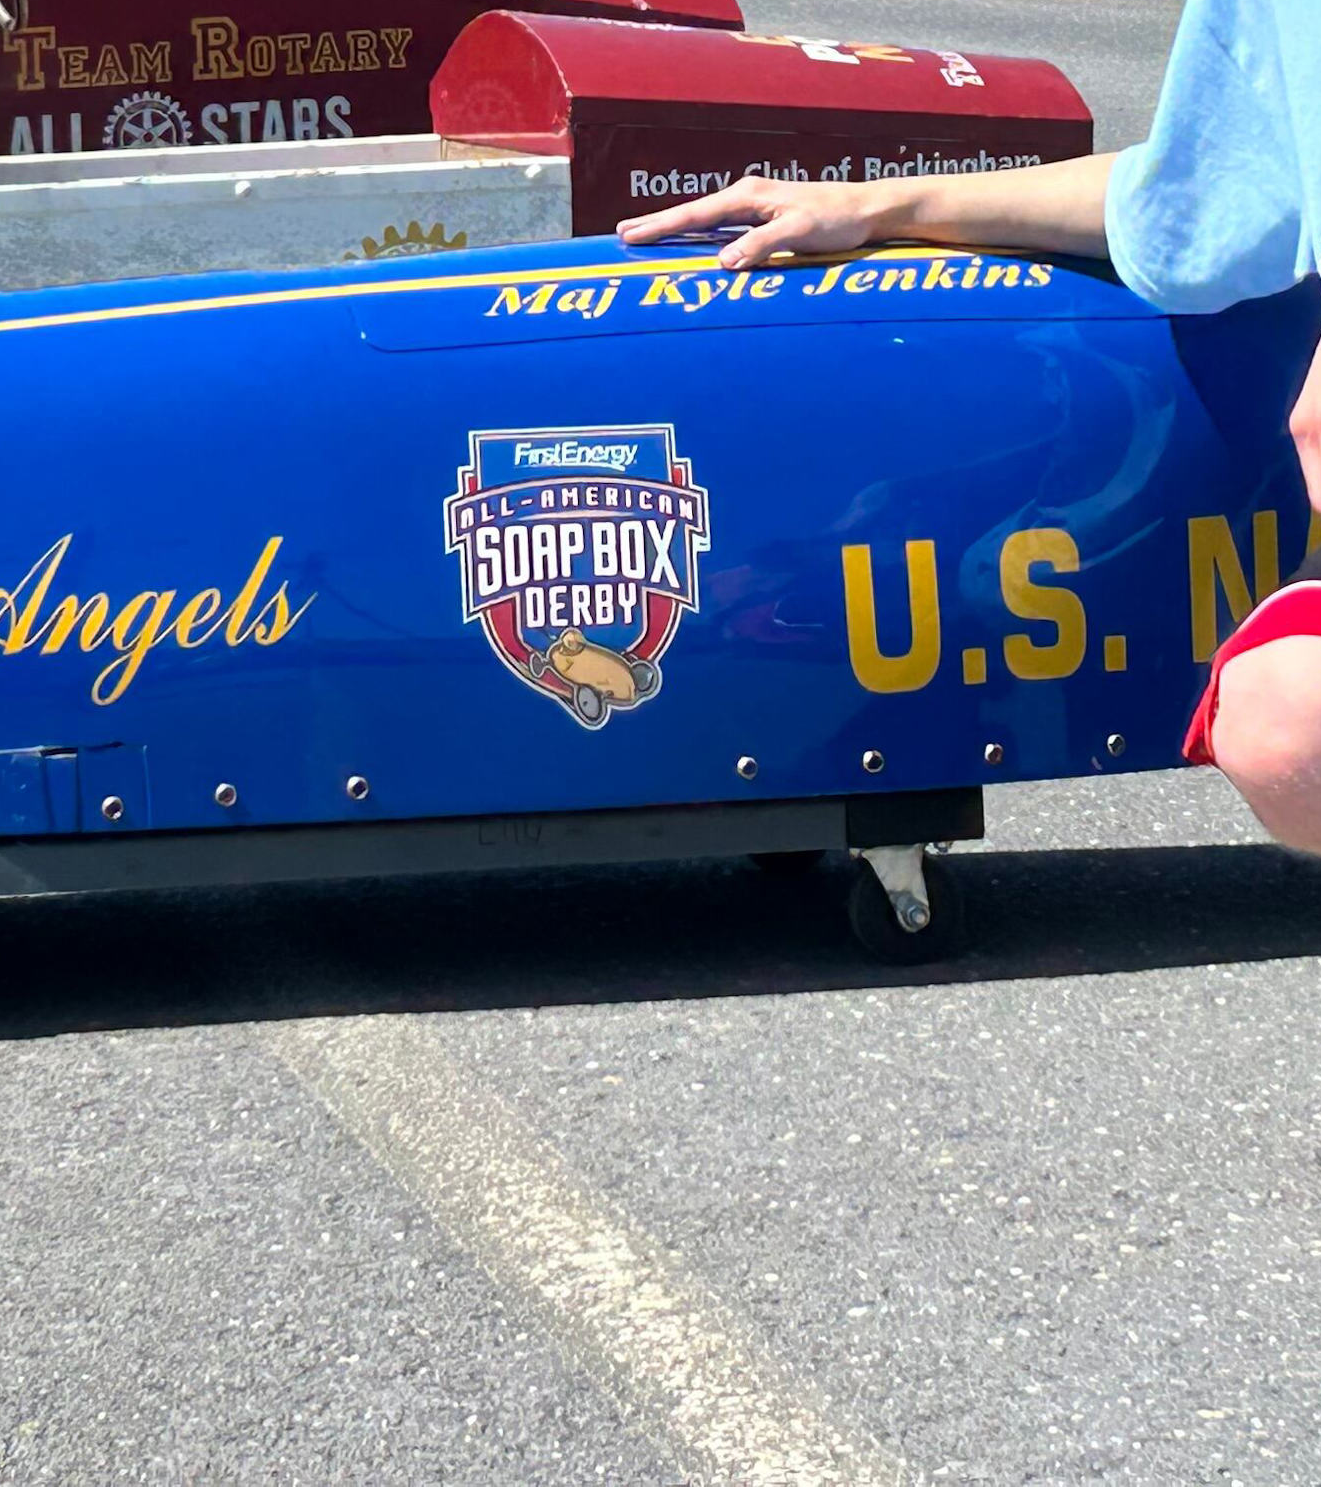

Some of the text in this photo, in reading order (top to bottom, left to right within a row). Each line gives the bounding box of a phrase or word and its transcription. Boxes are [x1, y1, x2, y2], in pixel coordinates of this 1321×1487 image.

[3, 16, 413, 91] TEAM ROTARY
[630, 169, 731, 197] Rotary
[820, 156, 852, 182] of
[485, 257, 1054, 319] Maj Kyle Jenkins
[515, 441, 639, 467] FirstEnergy
[461, 486, 694, 529] ALL-AMERICAN
[476, 519, 680, 597] SOAP BOX
[525, 582, 638, 628] DERBY
[841, 527, 1127, 694] U.S.
